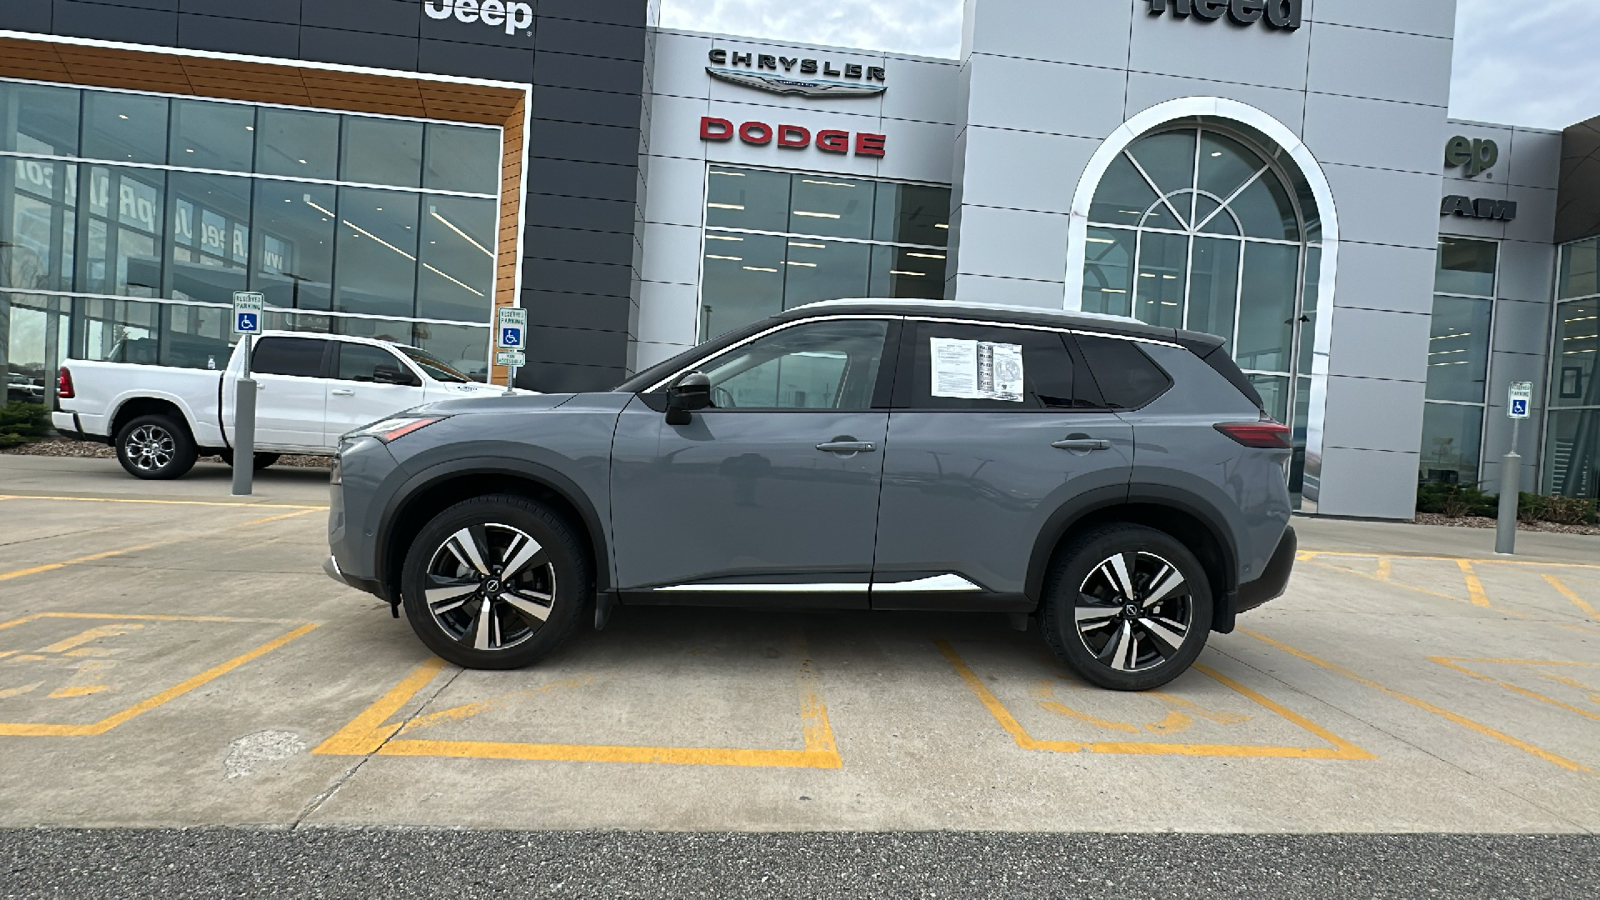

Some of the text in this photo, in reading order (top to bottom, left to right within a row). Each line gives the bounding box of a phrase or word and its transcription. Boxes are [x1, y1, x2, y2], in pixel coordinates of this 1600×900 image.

[425, 0, 532, 35] Jeep
[708, 49, 886, 80] CHRYSLER
[700, 116, 886, 158] DODGE
[236, 302, 260, 310] PARKING
[501, 317, 524, 325] PARKING
